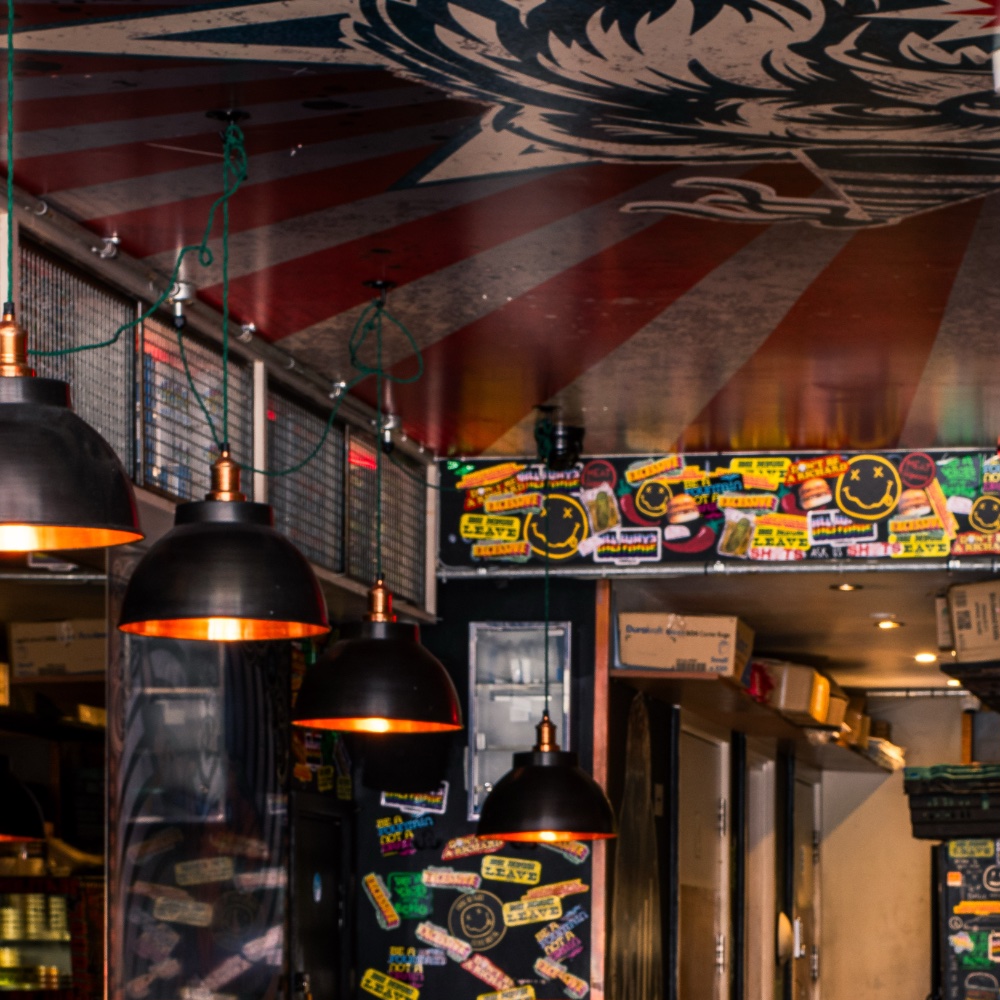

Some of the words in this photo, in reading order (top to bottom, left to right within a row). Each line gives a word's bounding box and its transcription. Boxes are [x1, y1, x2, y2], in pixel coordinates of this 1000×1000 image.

[464, 525, 517, 537] LEAVE
[754, 537, 808, 546] LEAVE
[902, 543, 948, 552] EAVE
[485, 866, 537, 881] LEAVE
[507, 906, 560, 923] LEAVE
